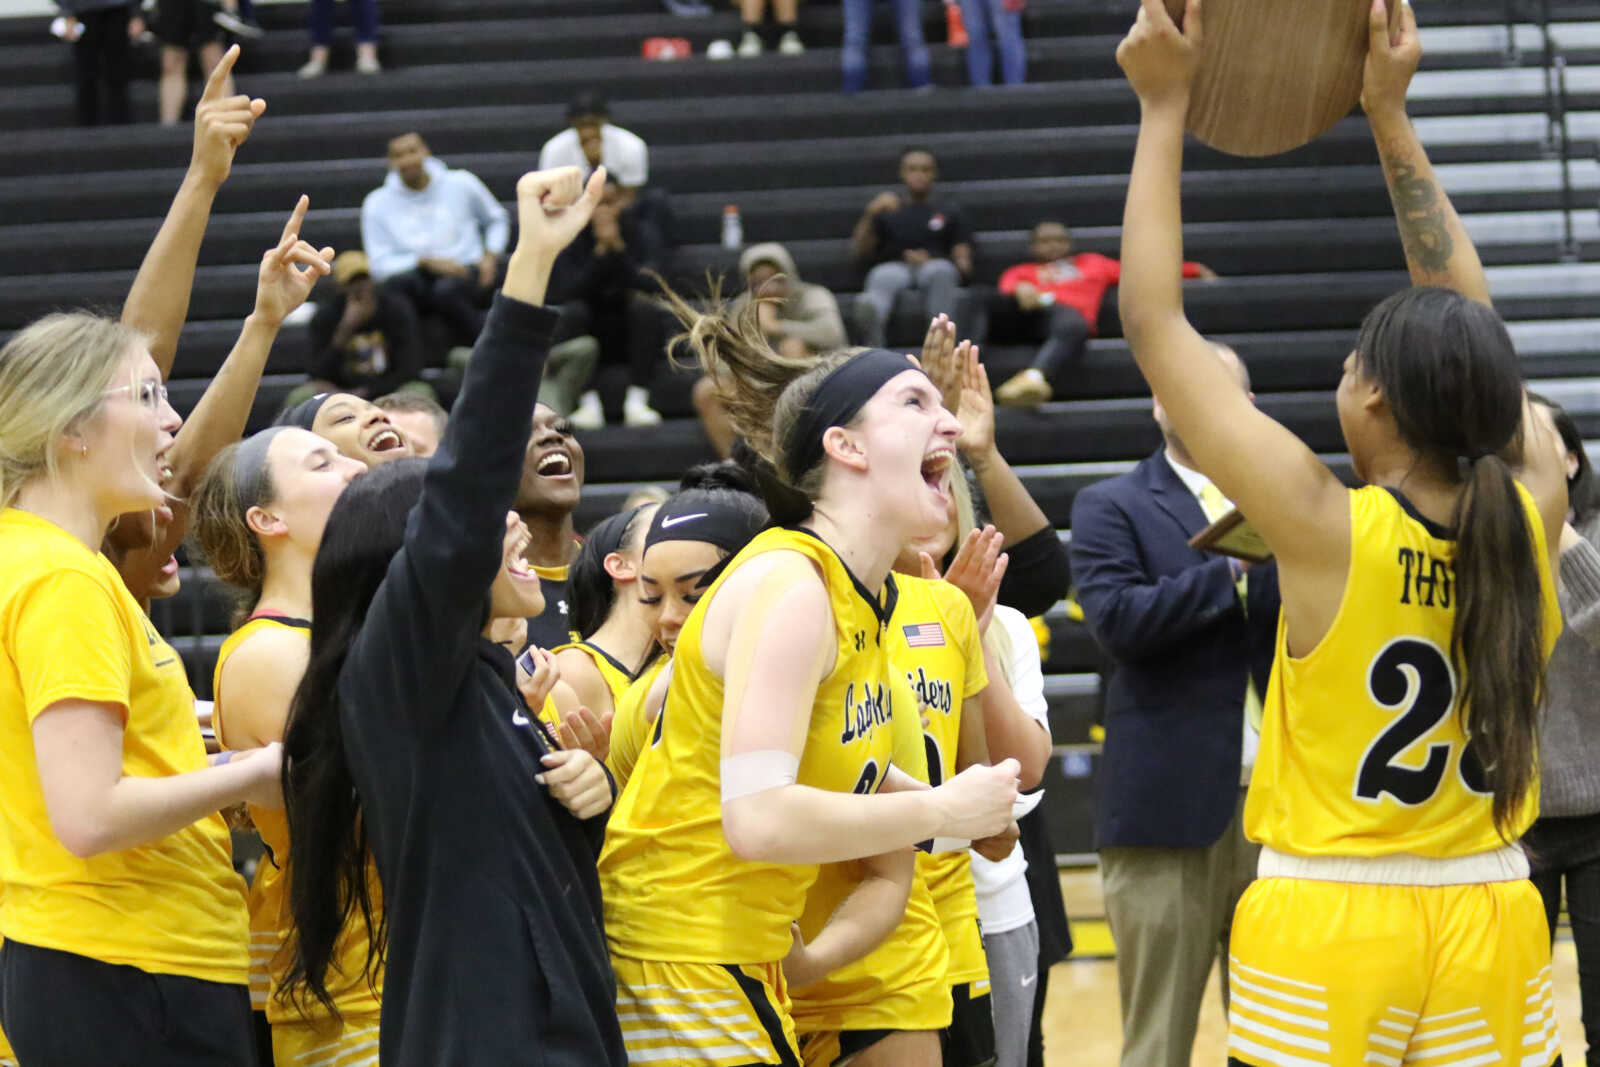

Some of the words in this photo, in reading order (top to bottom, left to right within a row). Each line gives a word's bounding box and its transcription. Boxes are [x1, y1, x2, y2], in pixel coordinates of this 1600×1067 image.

[1398, 547, 1455, 609] THO
[841, 682, 873, 745] Lad
[906, 667, 952, 714] iders
